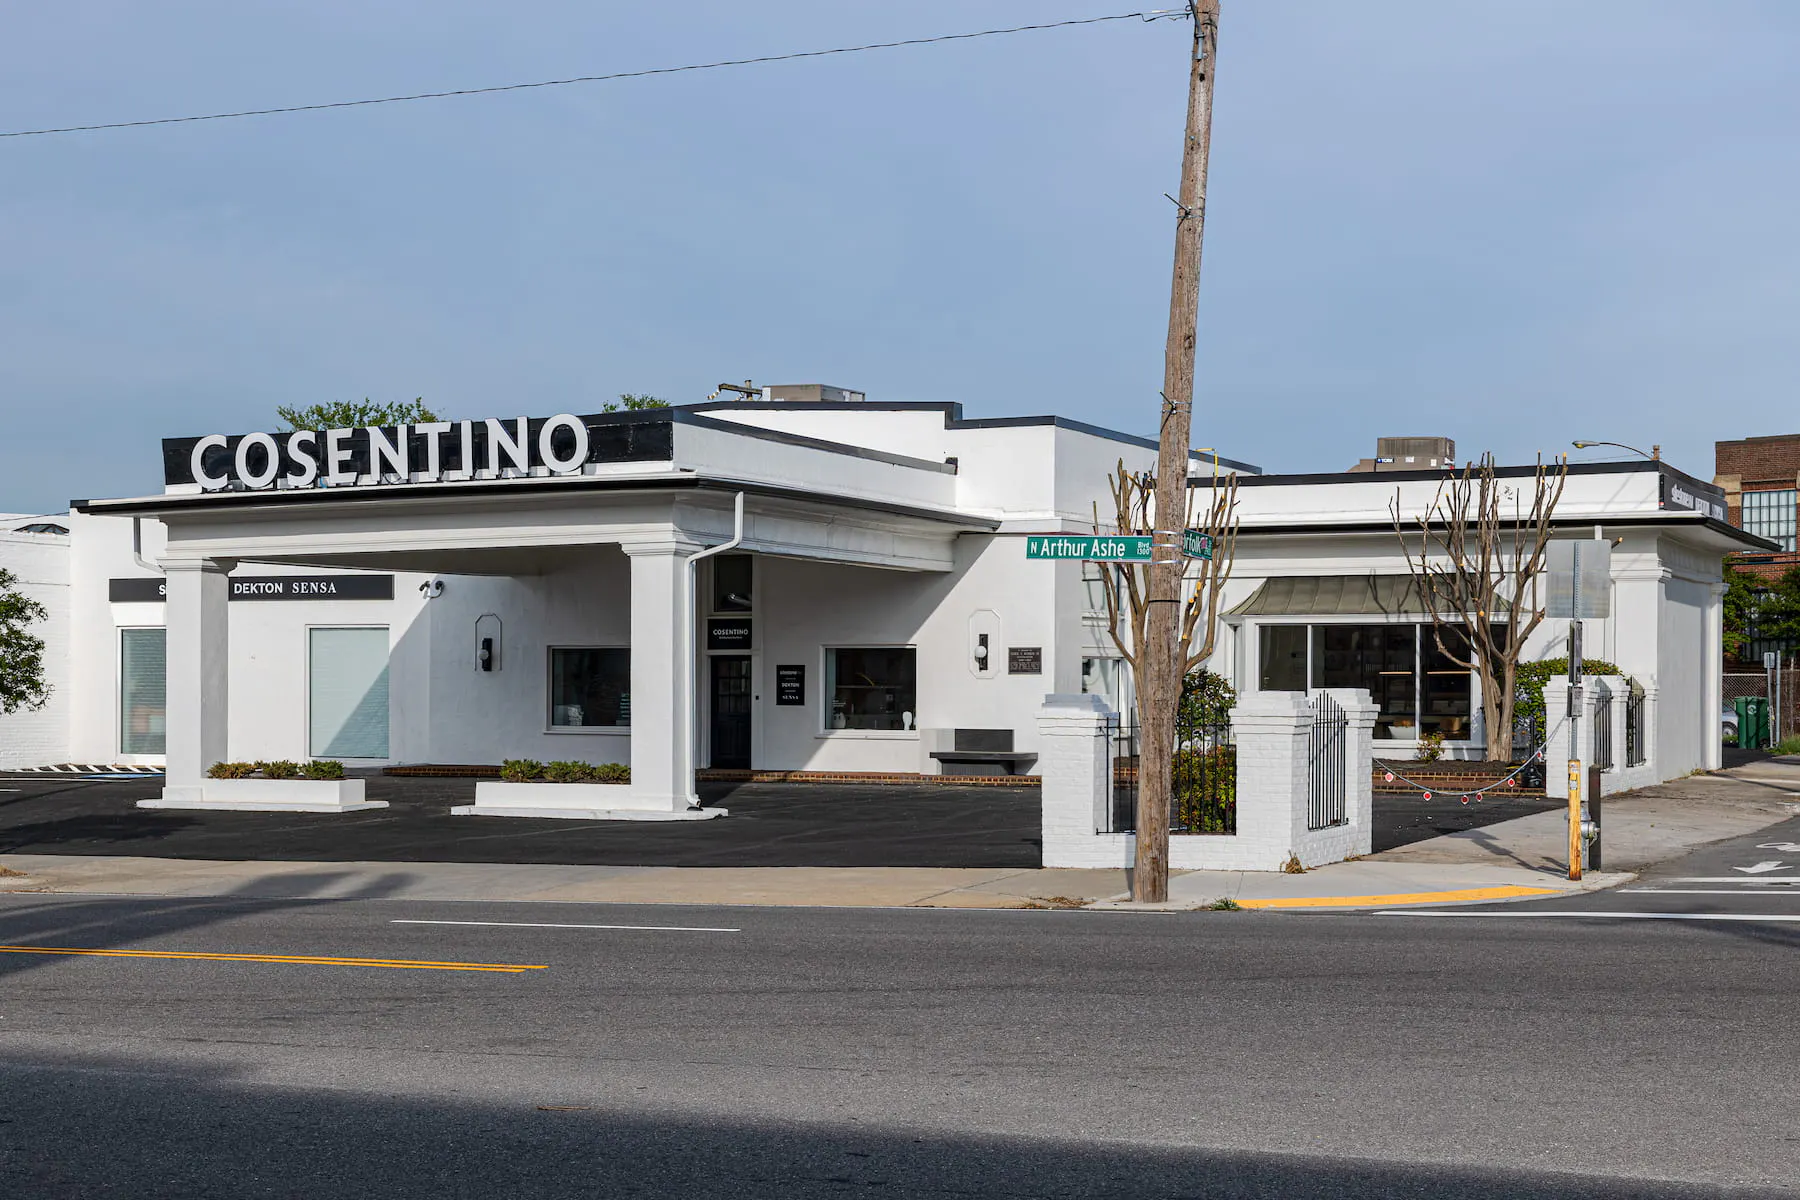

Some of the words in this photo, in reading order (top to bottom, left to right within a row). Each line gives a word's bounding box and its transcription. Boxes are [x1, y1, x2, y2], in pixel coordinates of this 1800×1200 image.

[190, 413, 589, 490] COSENTINO
[1030, 541, 1037, 554] N
[1040, 538, 1087, 557] Arthur
[1091, 538, 1125, 557] Ashe
[1183, 533, 1202, 554] rfolk
[233, 582, 283, 595] DEKTON
[292, 582, 337, 594] SENSA
